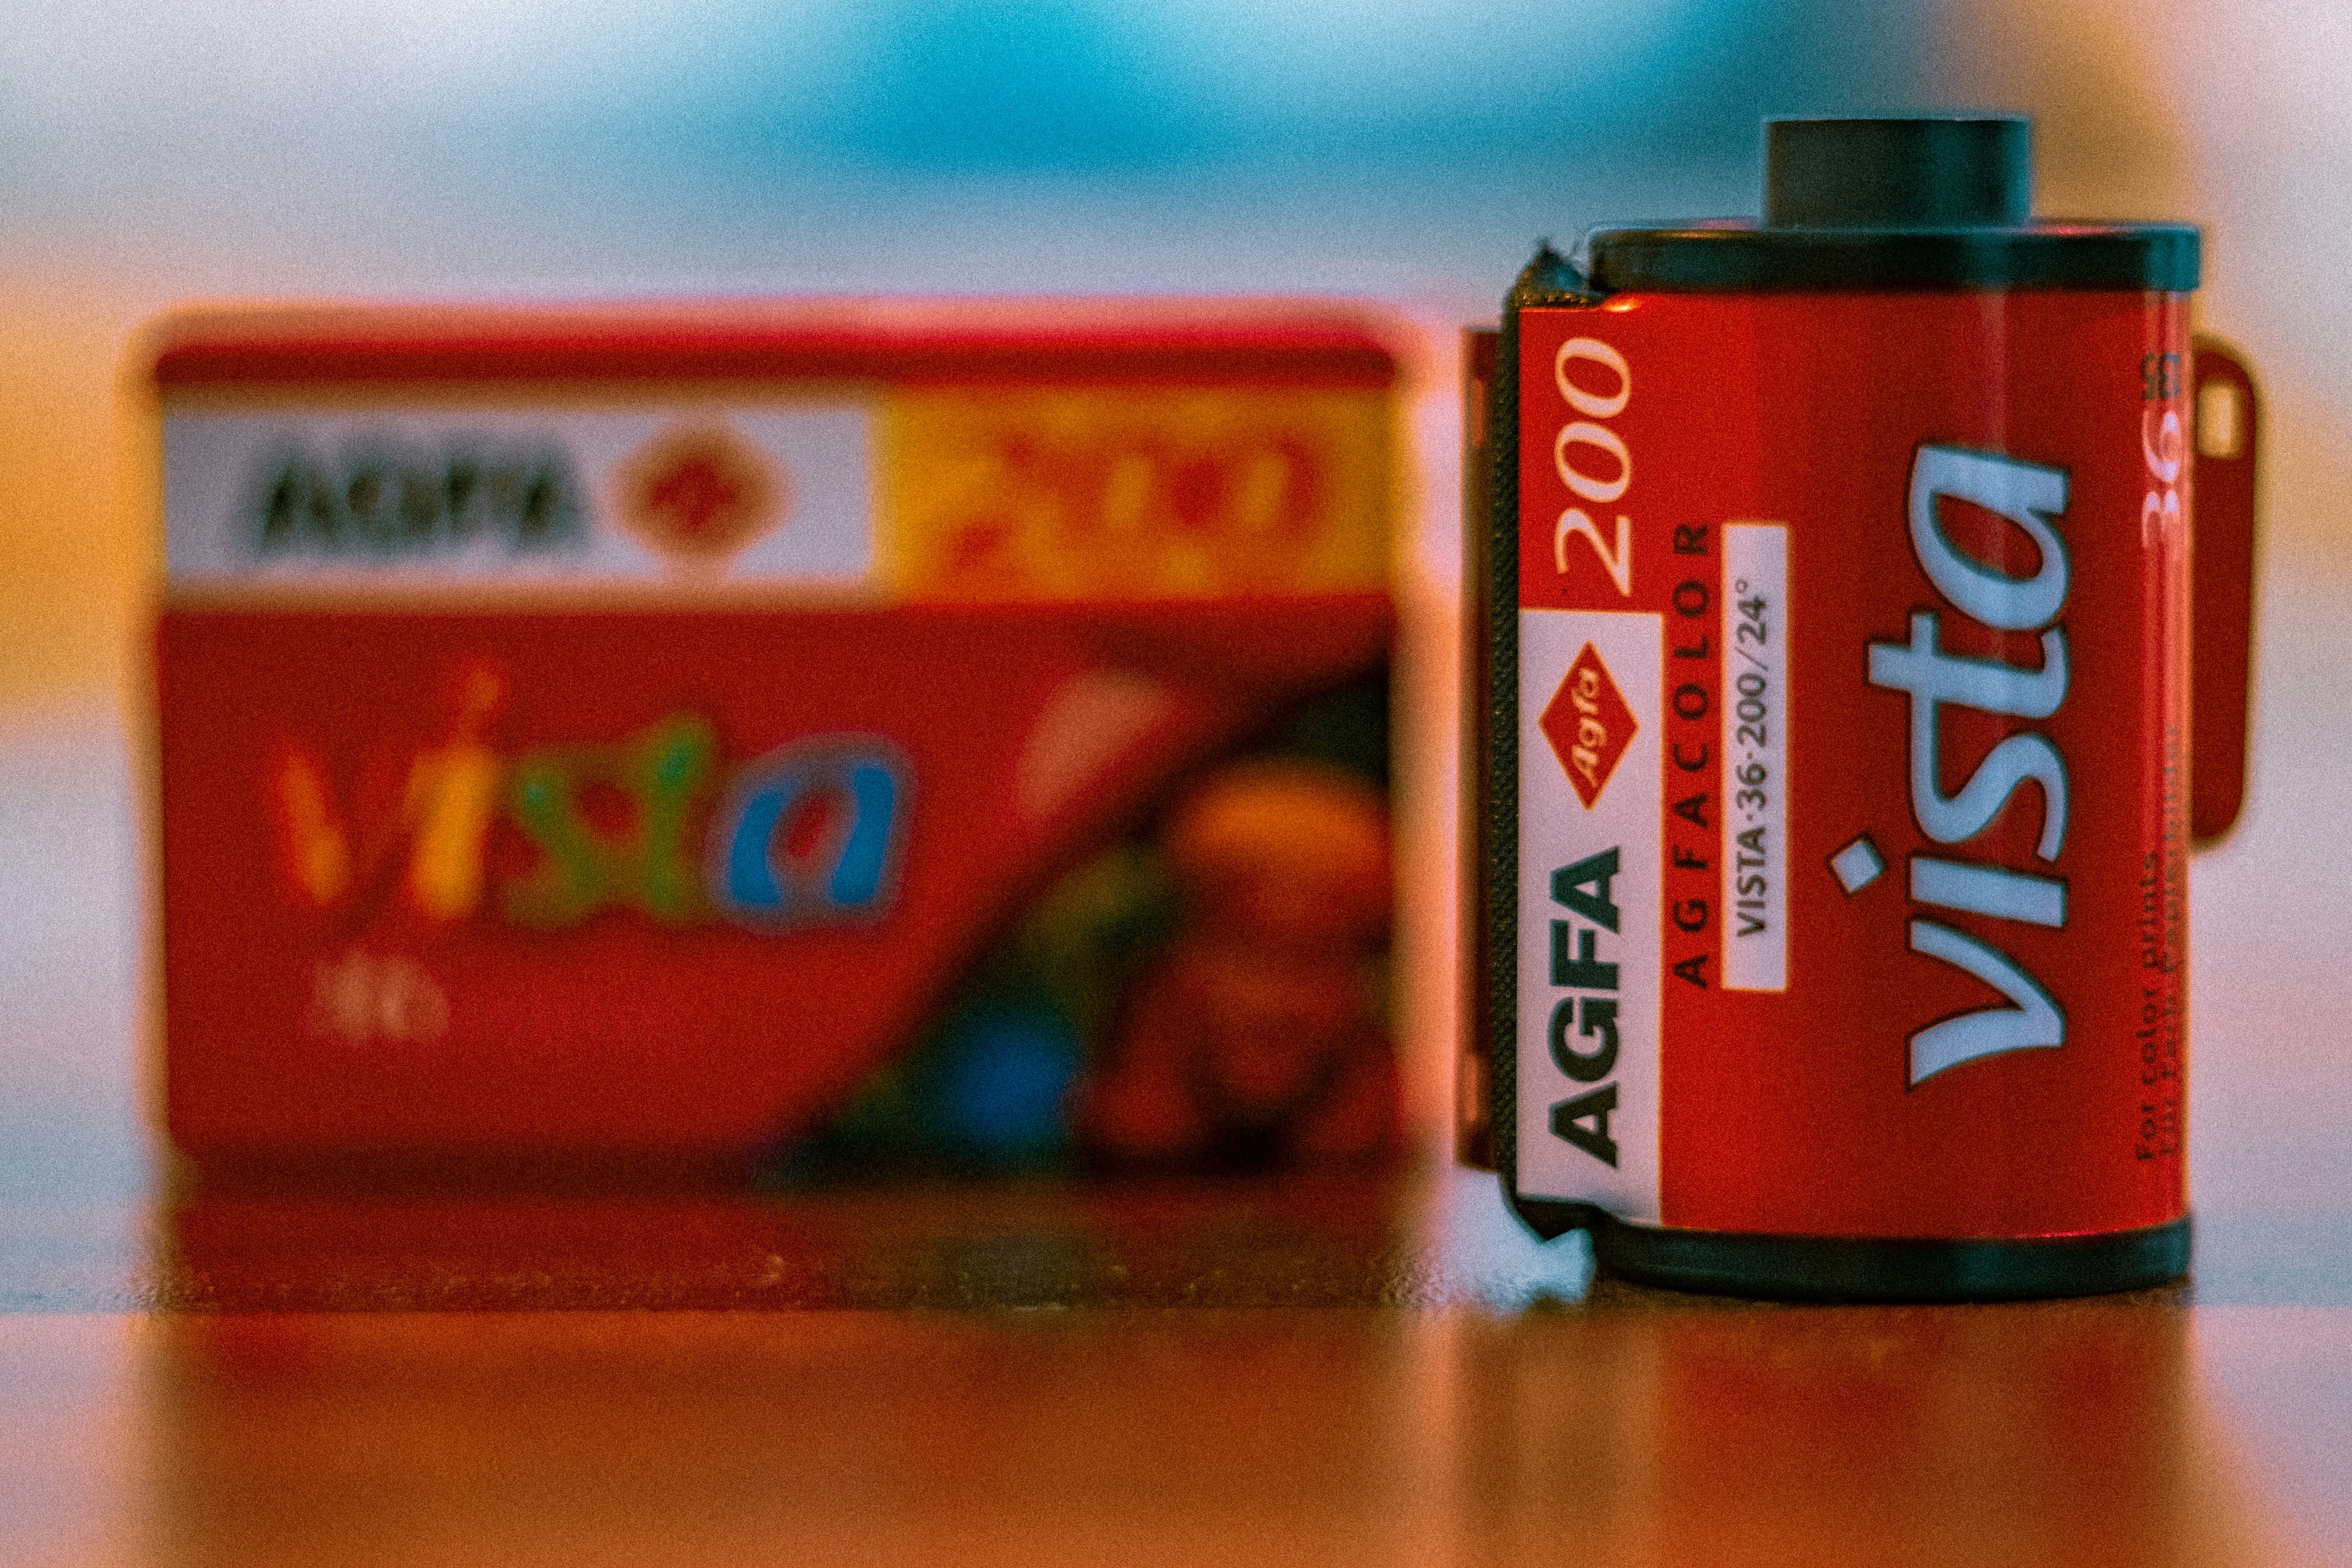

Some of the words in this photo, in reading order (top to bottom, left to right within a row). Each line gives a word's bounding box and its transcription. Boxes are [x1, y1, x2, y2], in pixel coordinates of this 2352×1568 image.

[1554, 336, 1633, 598] 200
[2141, 408, 2181, 549] 36
[1571, 667, 1607, 788] Agfa
[1673, 523, 1709, 990] AGFACOLOR
[1826, 444, 2071, 1090] vista
[2138, 851, 2162, 968] prints
[1547, 845, 1621, 1170] AGFA
[2136, 985, 2158, 1087] color
[2136, 1102, 2157, 1160] For
